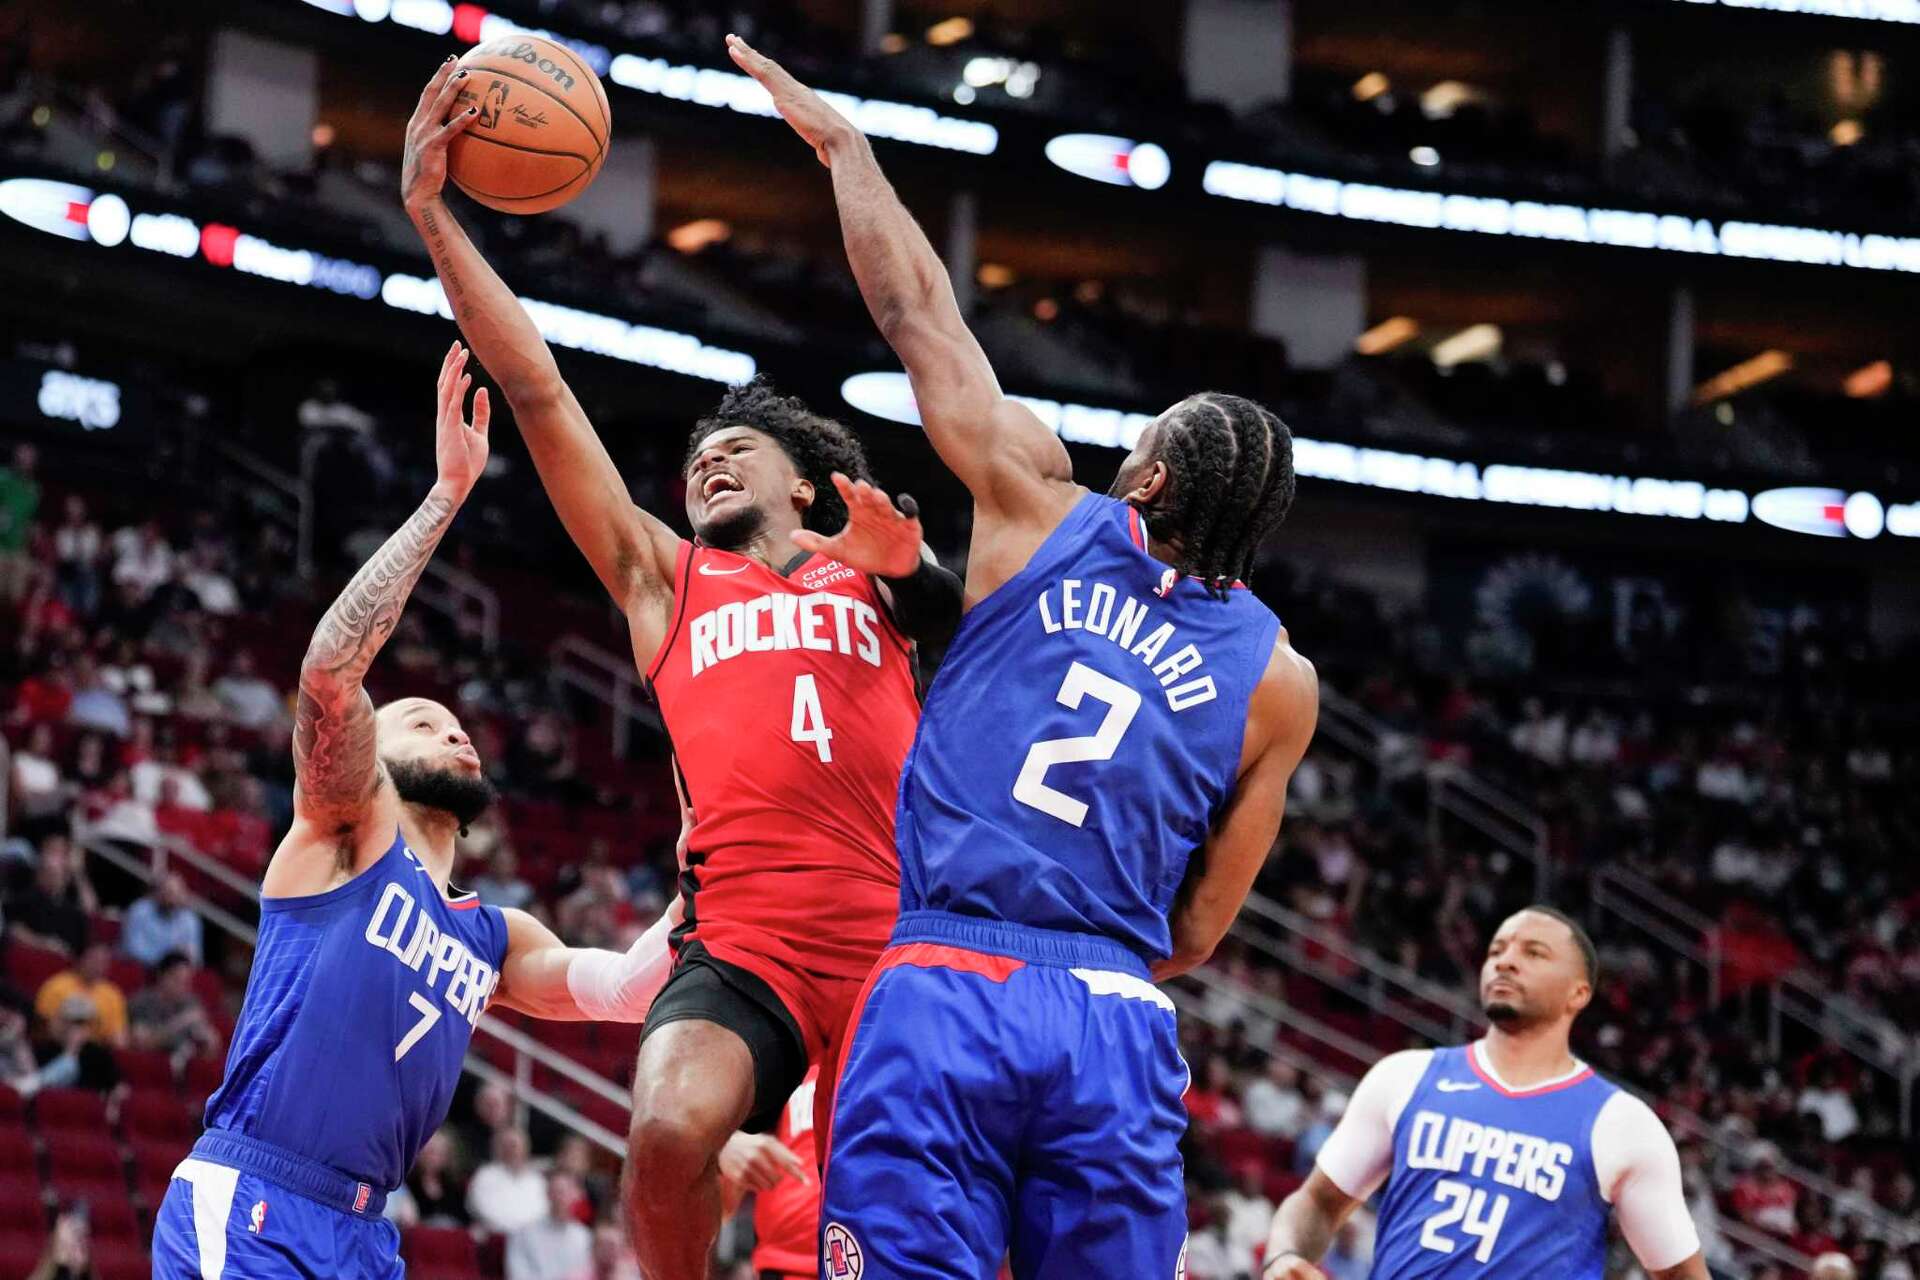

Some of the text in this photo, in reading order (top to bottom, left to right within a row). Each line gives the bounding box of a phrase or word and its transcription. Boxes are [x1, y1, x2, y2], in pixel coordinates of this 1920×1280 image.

[482, 42, 575, 92] ilson
[803, 568, 855, 590] karma
[690, 592, 881, 678] ROCKETS
[1038, 579, 1217, 713] LEONARD
[790, 673, 833, 763] 4
[1012, 661, 1142, 828] 2
[395, 991, 442, 1062] 7
[1407, 1110, 1573, 1202] CLIPPERS
[1420, 1179, 1510, 1264] 24
